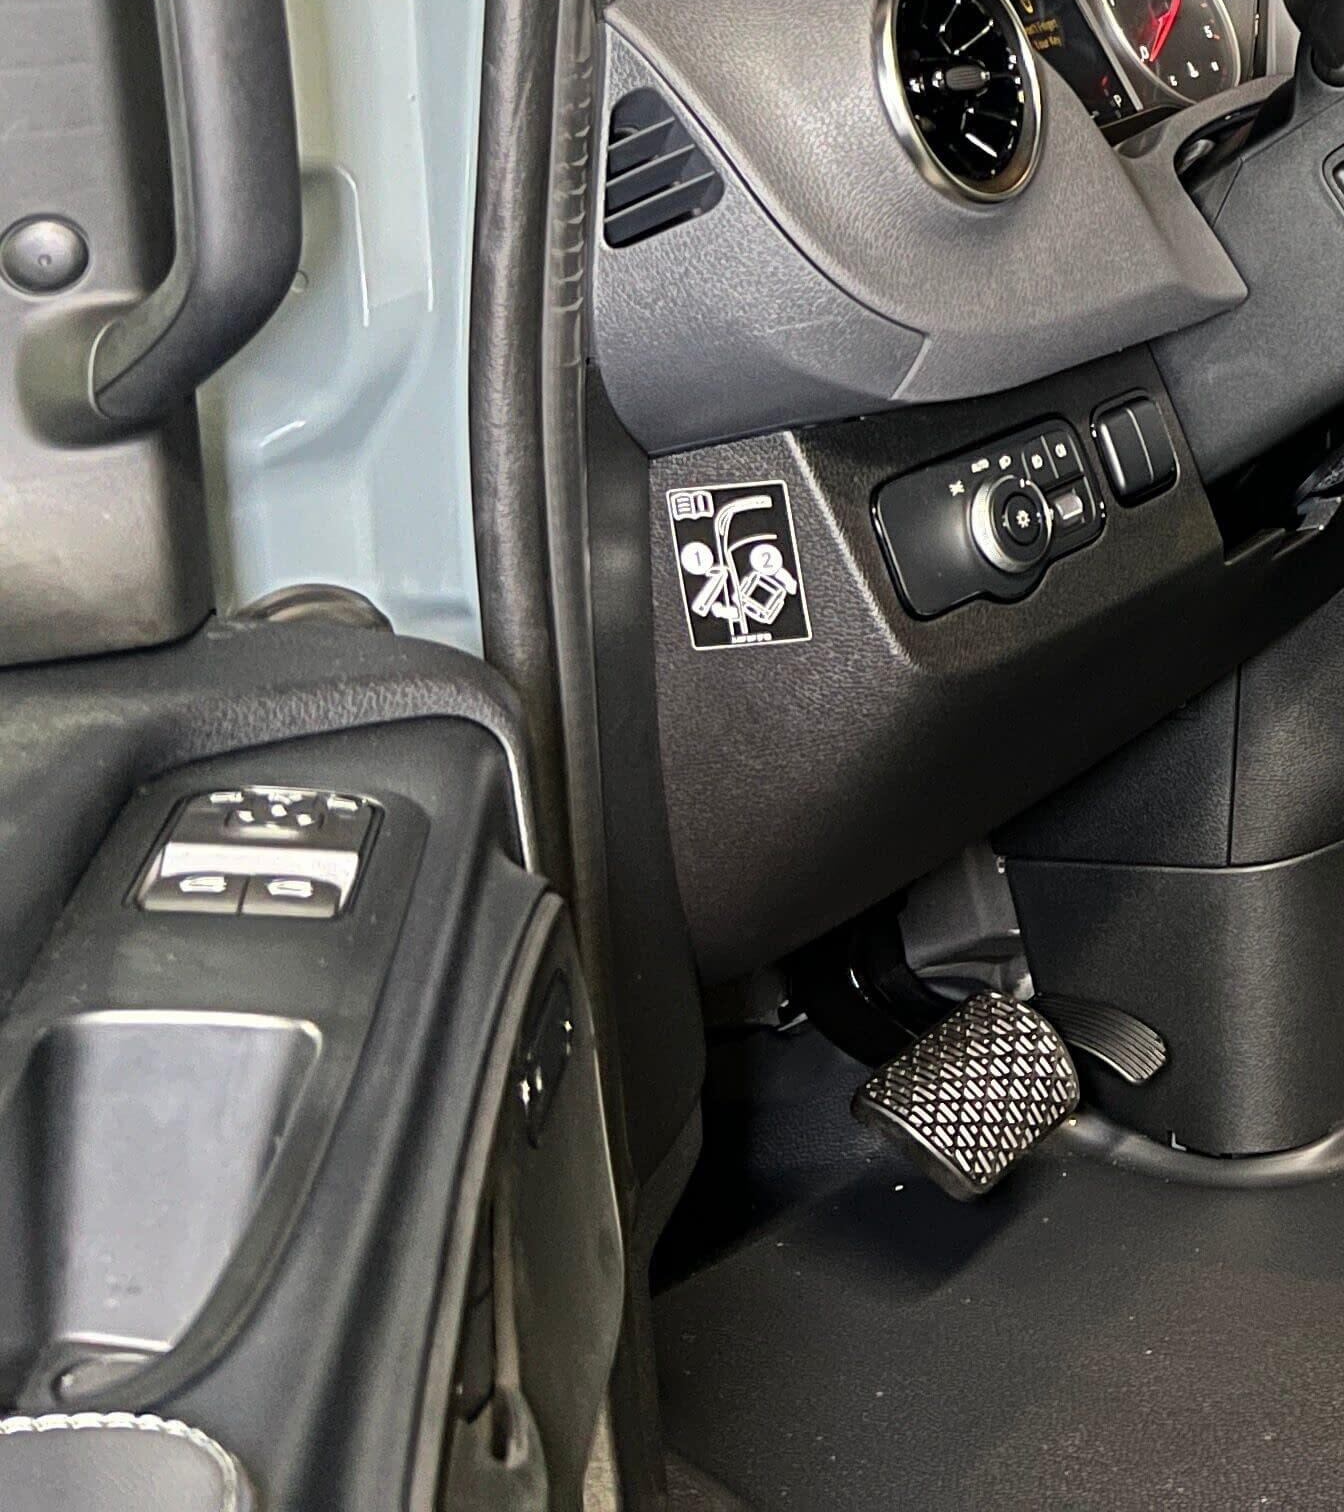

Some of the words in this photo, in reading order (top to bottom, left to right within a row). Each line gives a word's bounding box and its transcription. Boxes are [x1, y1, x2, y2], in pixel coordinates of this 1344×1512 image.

[1205, 26, 1214, 39] 5
[1139, 45, 1149, 60] 0
[761, 552, 773, 568] 2
